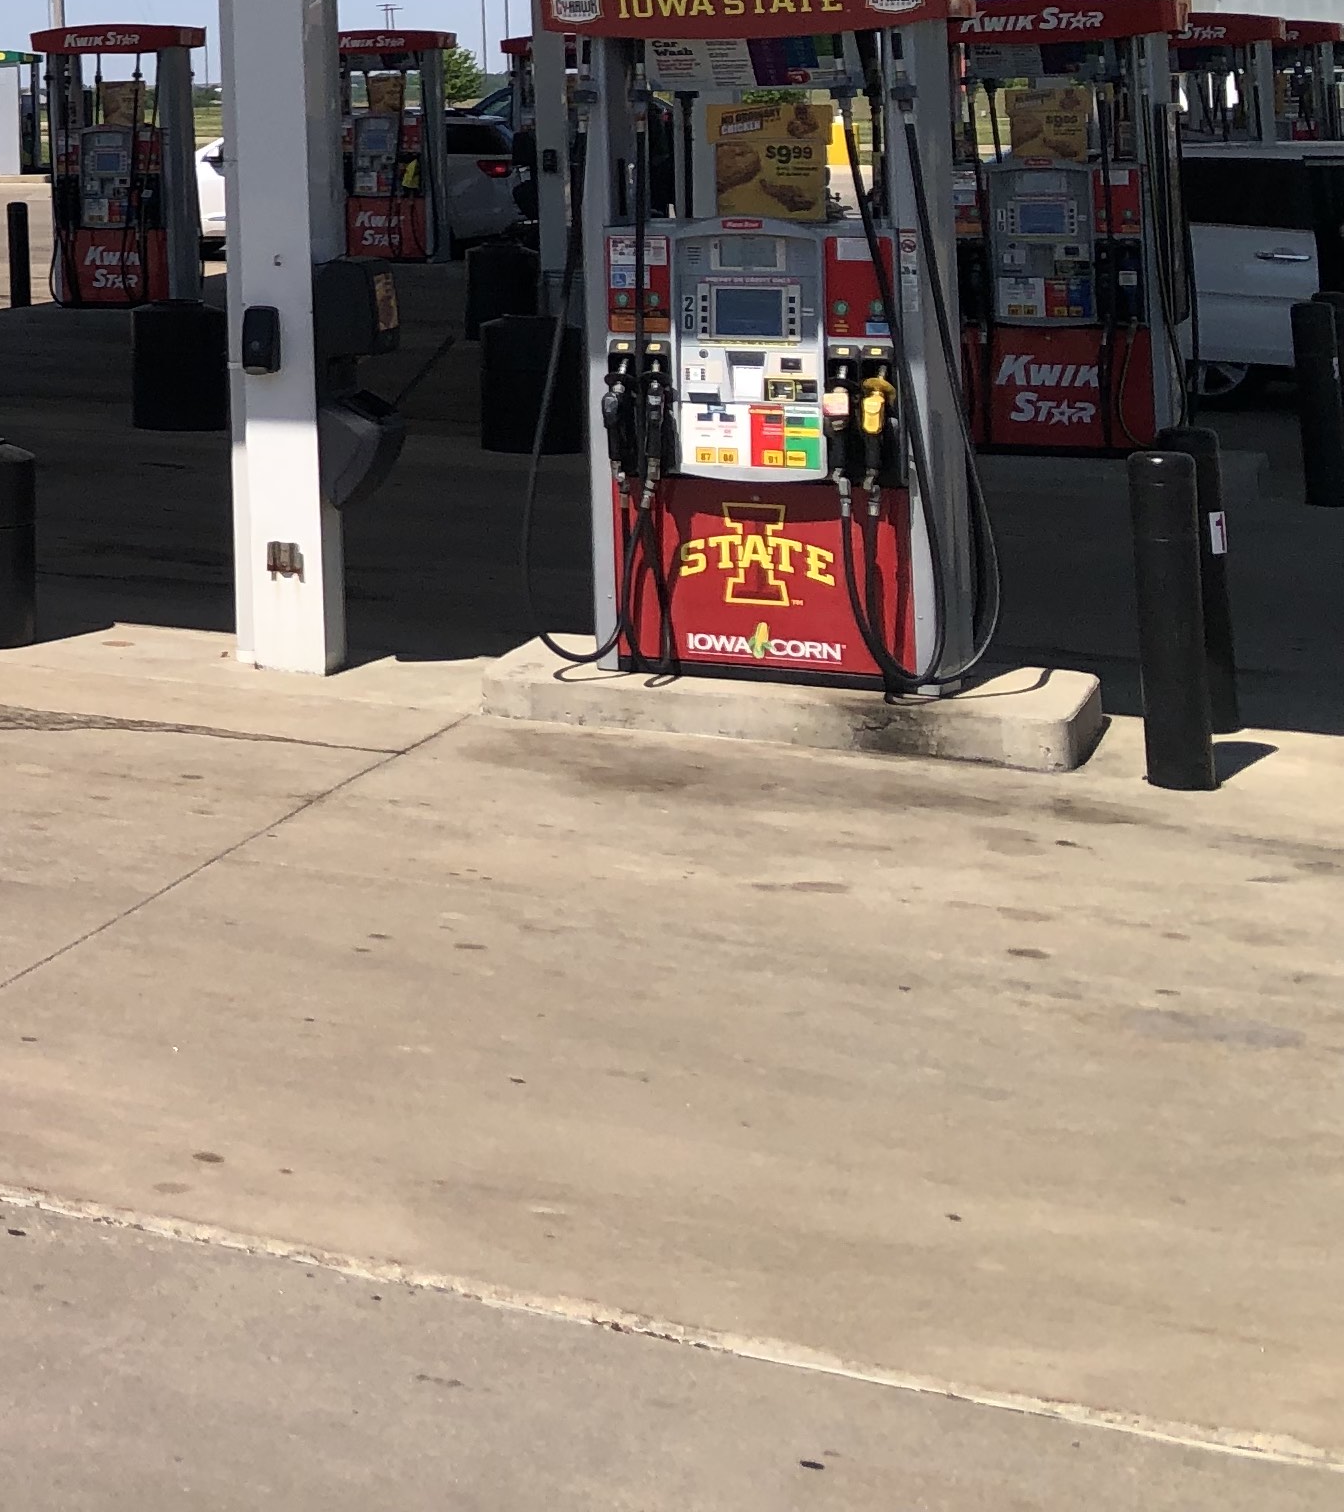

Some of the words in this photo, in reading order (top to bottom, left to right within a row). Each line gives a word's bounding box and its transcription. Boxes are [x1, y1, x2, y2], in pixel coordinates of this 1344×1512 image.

[1039, 6, 1105, 31] STAR
[64, 33, 103, 47] KWIK
[1010, 391, 1097, 426] STAR
[680, 534, 835, 587] STATE
[686, 632, 753, 654] IOWA
[770, 638, 842, 660] CORN
